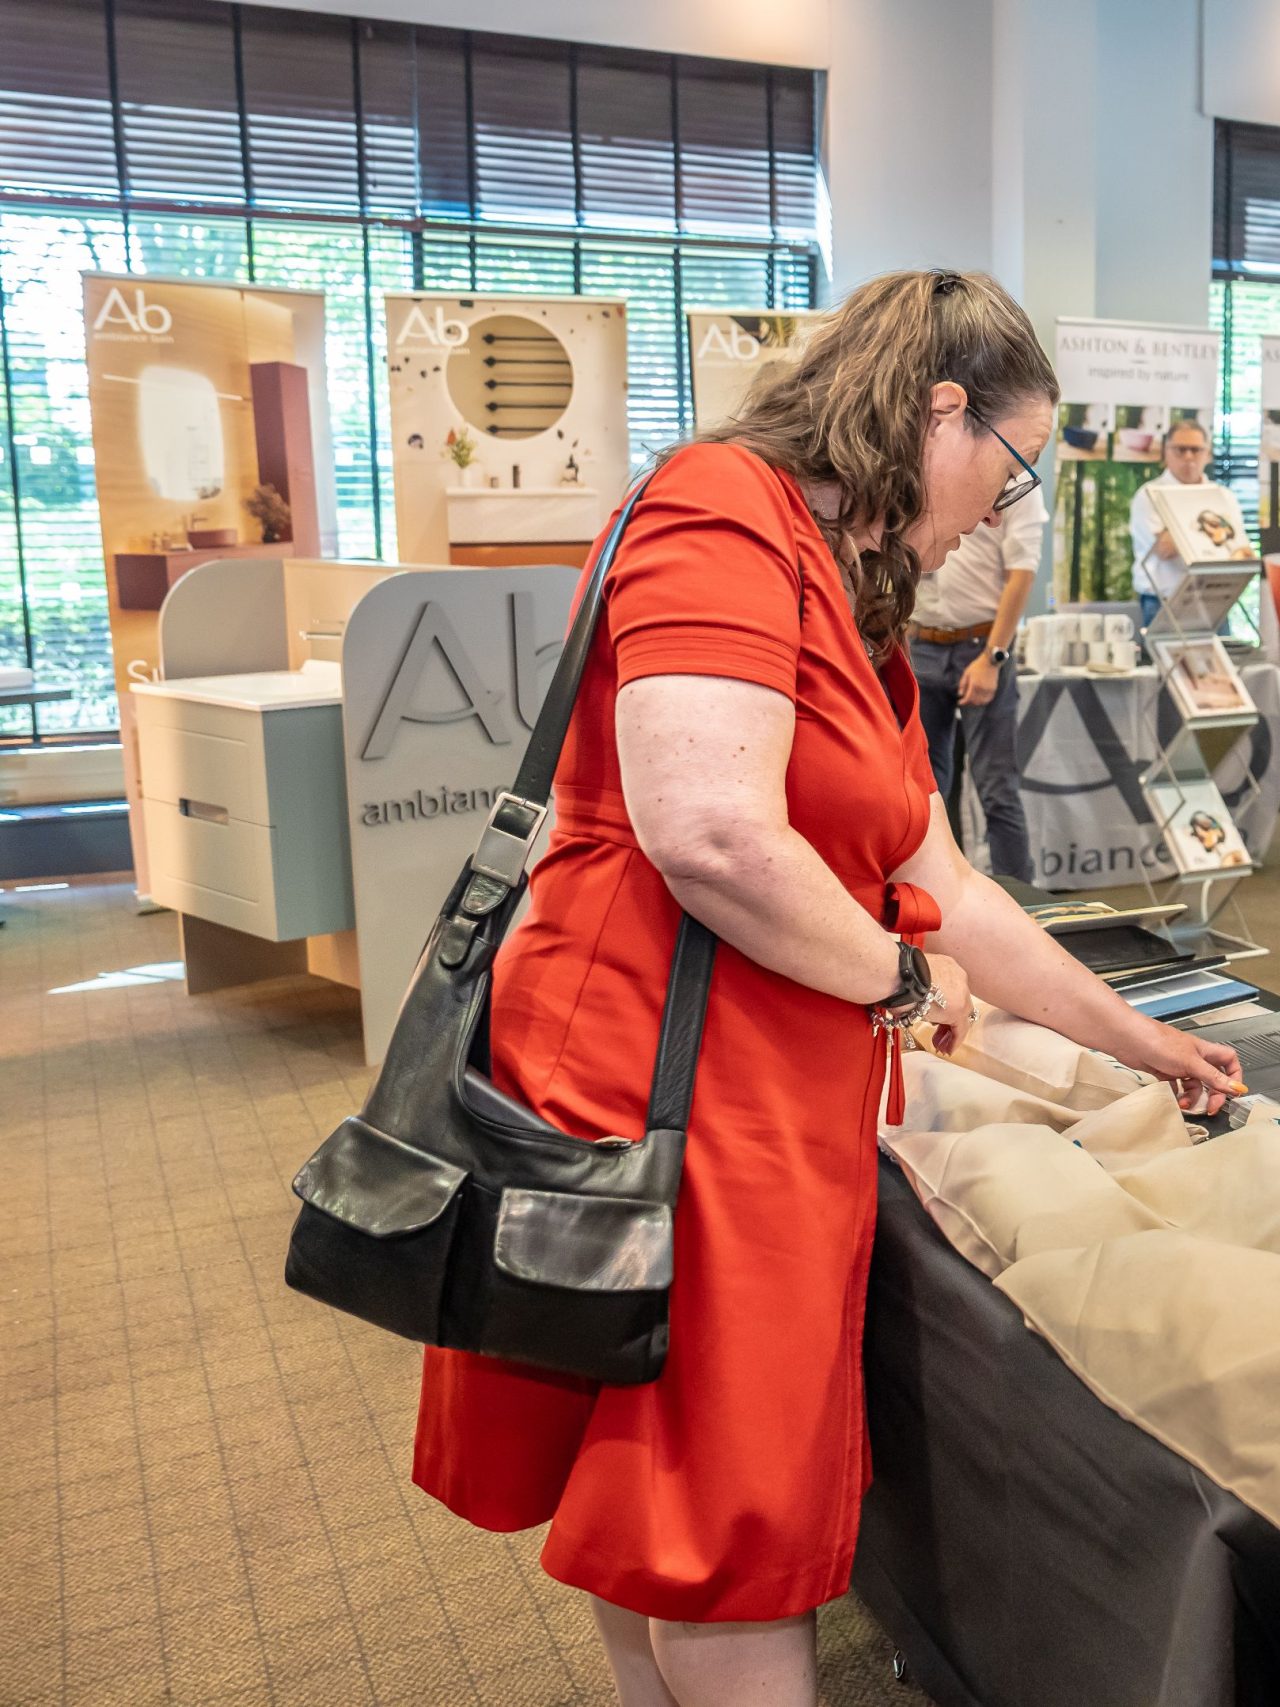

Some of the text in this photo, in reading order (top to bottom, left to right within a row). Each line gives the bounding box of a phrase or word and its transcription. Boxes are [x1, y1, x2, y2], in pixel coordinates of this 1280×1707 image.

[93, 286, 172, 334] Ab
[396, 305, 469, 347] Ab
[697, 322, 760, 360] Ab
[1060, 335, 1218, 359] ASHTON & BENTLEY
[1088, 367, 1135, 380] inspired
[361, 785, 513, 827] ambian
[1040, 838, 1174, 878] biance
